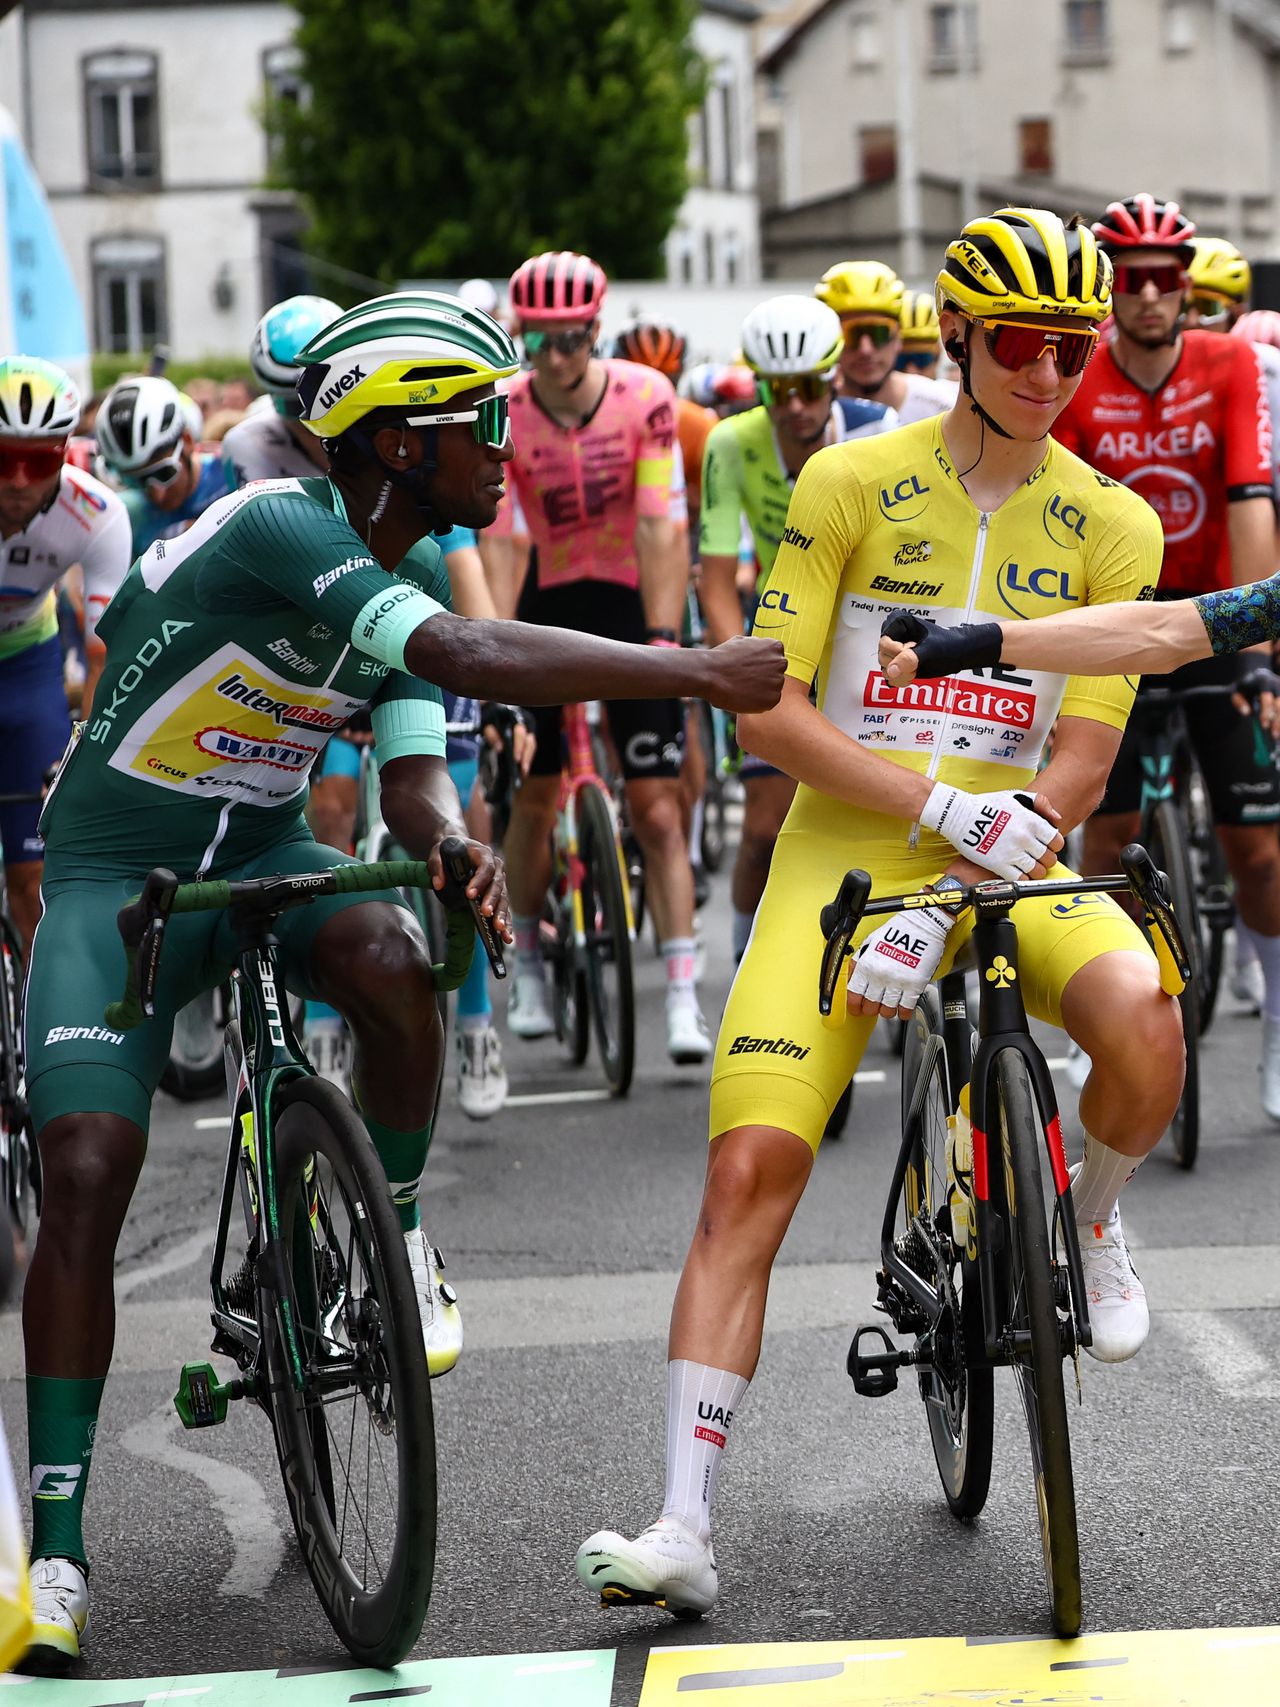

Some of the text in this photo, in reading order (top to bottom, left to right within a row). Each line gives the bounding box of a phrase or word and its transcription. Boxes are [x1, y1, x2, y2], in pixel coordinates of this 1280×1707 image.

[957, 242, 996, 278] MET
[1041, 304, 1080, 314] MET
[319, 364, 367, 410] uvex
[1095, 421, 1216, 461] ARKEA
[934, 447, 952, 478] LCL
[1026, 463, 1047, 486] LCL
[881, 474, 930, 508] LCL
[1049, 495, 1086, 541] LCL
[780, 527, 815, 551] ntini
[312, 556, 374, 599] Santini
[869, 575, 944, 598] Santini
[1006, 563, 1079, 601] LCL
[851, 601, 874, 612] Tadej
[266, 637, 322, 676] Santini
[870, 675, 1030, 724] Emirates
[910, 717, 941, 725] PISSEI
[951, 721, 995, 736] presight
[216, 735, 311, 765] WANTY
[146, 758, 188, 779] Circus
[962, 805, 999, 847] UAE
[978, 812, 1010, 853] Emirates
[291, 877, 326, 890] bryton
[980, 899, 1014, 907] wahoo
[876, 942, 918, 967] Emirates
[883, 927, 929, 957] UAE
[258, 961, 286, 1047] CUBE
[44, 1026, 125, 1046] Santini
[728, 1035, 811, 1060] Santini
[697, 1401, 734, 1429] UAE
